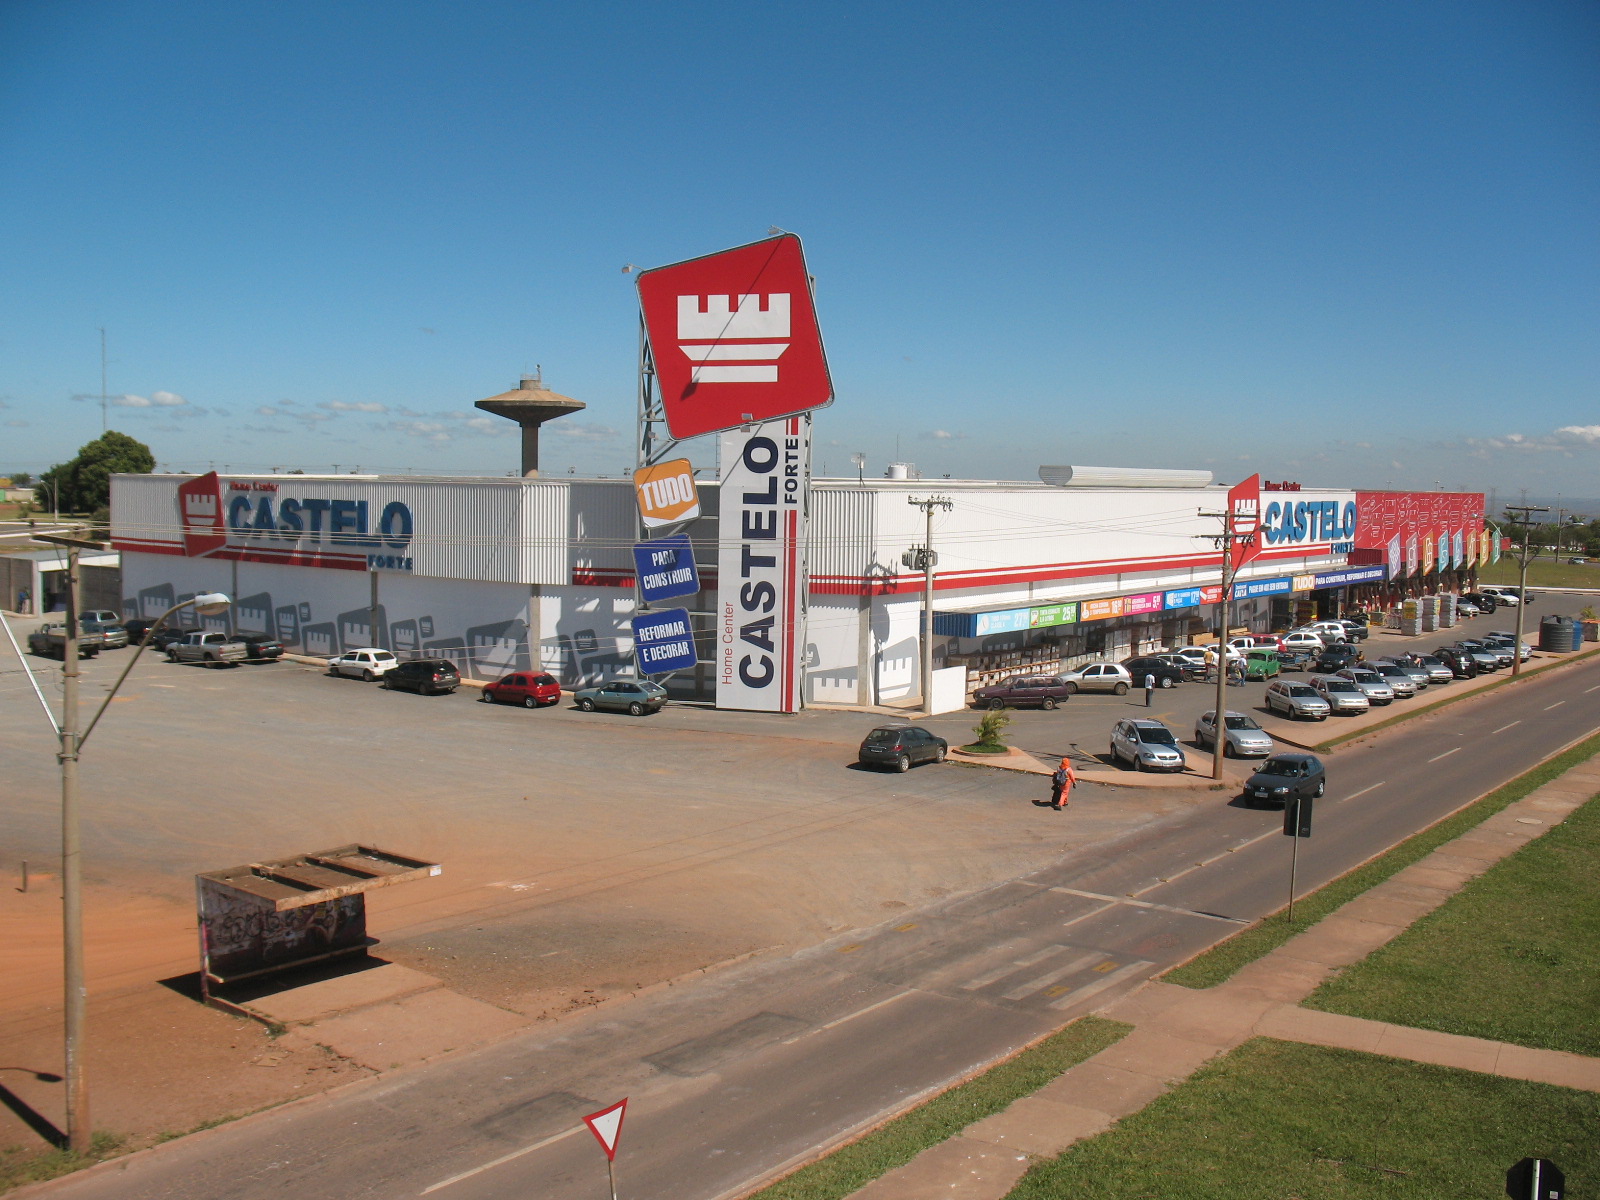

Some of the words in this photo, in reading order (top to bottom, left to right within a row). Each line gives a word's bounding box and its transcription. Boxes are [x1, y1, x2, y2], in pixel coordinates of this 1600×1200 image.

[784, 438, 798, 504] FORTE
[639, 474, 693, 510] TUDO
[230, 496, 412, 548] CASTELO
[1265, 500, 1356, 544] CASTELO
[368, 554, 412, 570] FORTE
[652, 550, 676, 566] PARA
[739, 436, 778, 688] CASTELO
[643, 568, 693, 590] CONSTRUIR
[1316, 577, 1325, 585] PARA
[639, 621, 686, 642] REFORMAR
[722, 602, 734, 644] Center
[643, 649, 650, 662] E
[650, 642, 690, 661] DECORAR
[722, 648, 732, 684] Home
